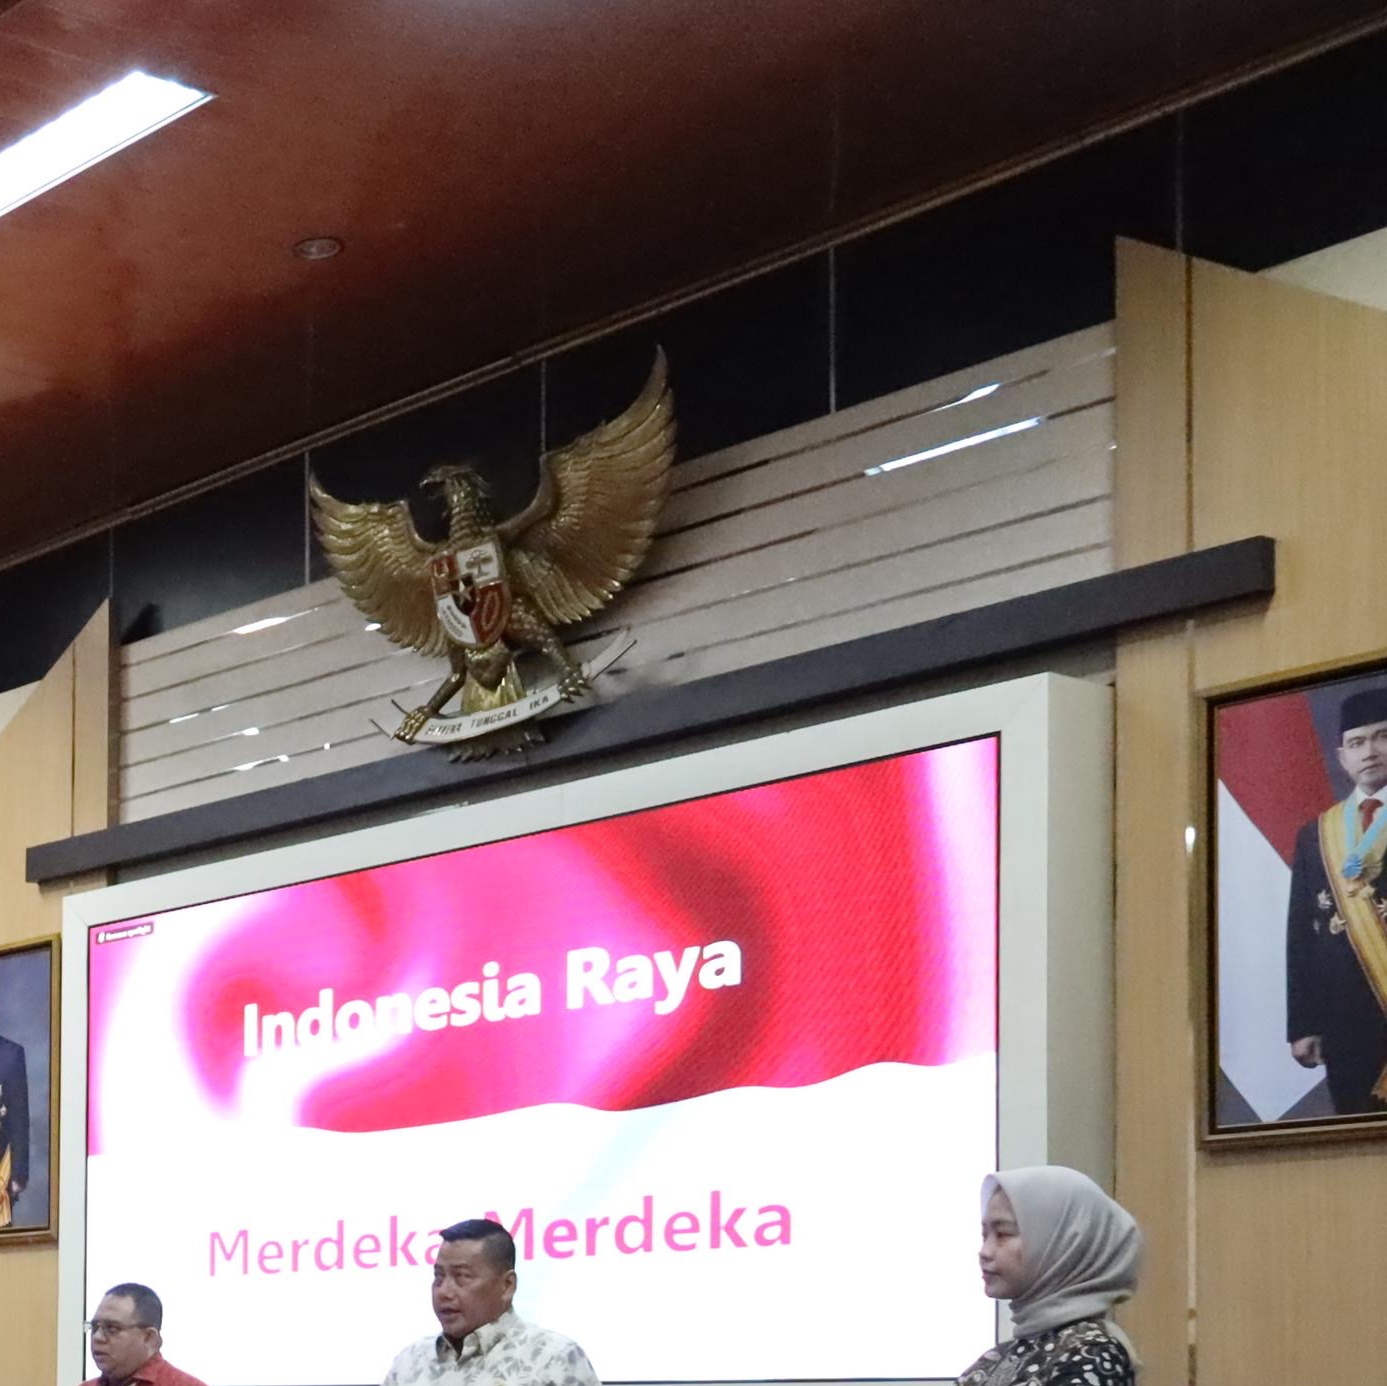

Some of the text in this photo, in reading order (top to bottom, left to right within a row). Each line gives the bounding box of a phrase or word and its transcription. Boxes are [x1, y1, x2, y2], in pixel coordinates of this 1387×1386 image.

[244, 939, 742, 1057] Indonesia Raya
[484, 1190, 793, 1262] Merdeka
